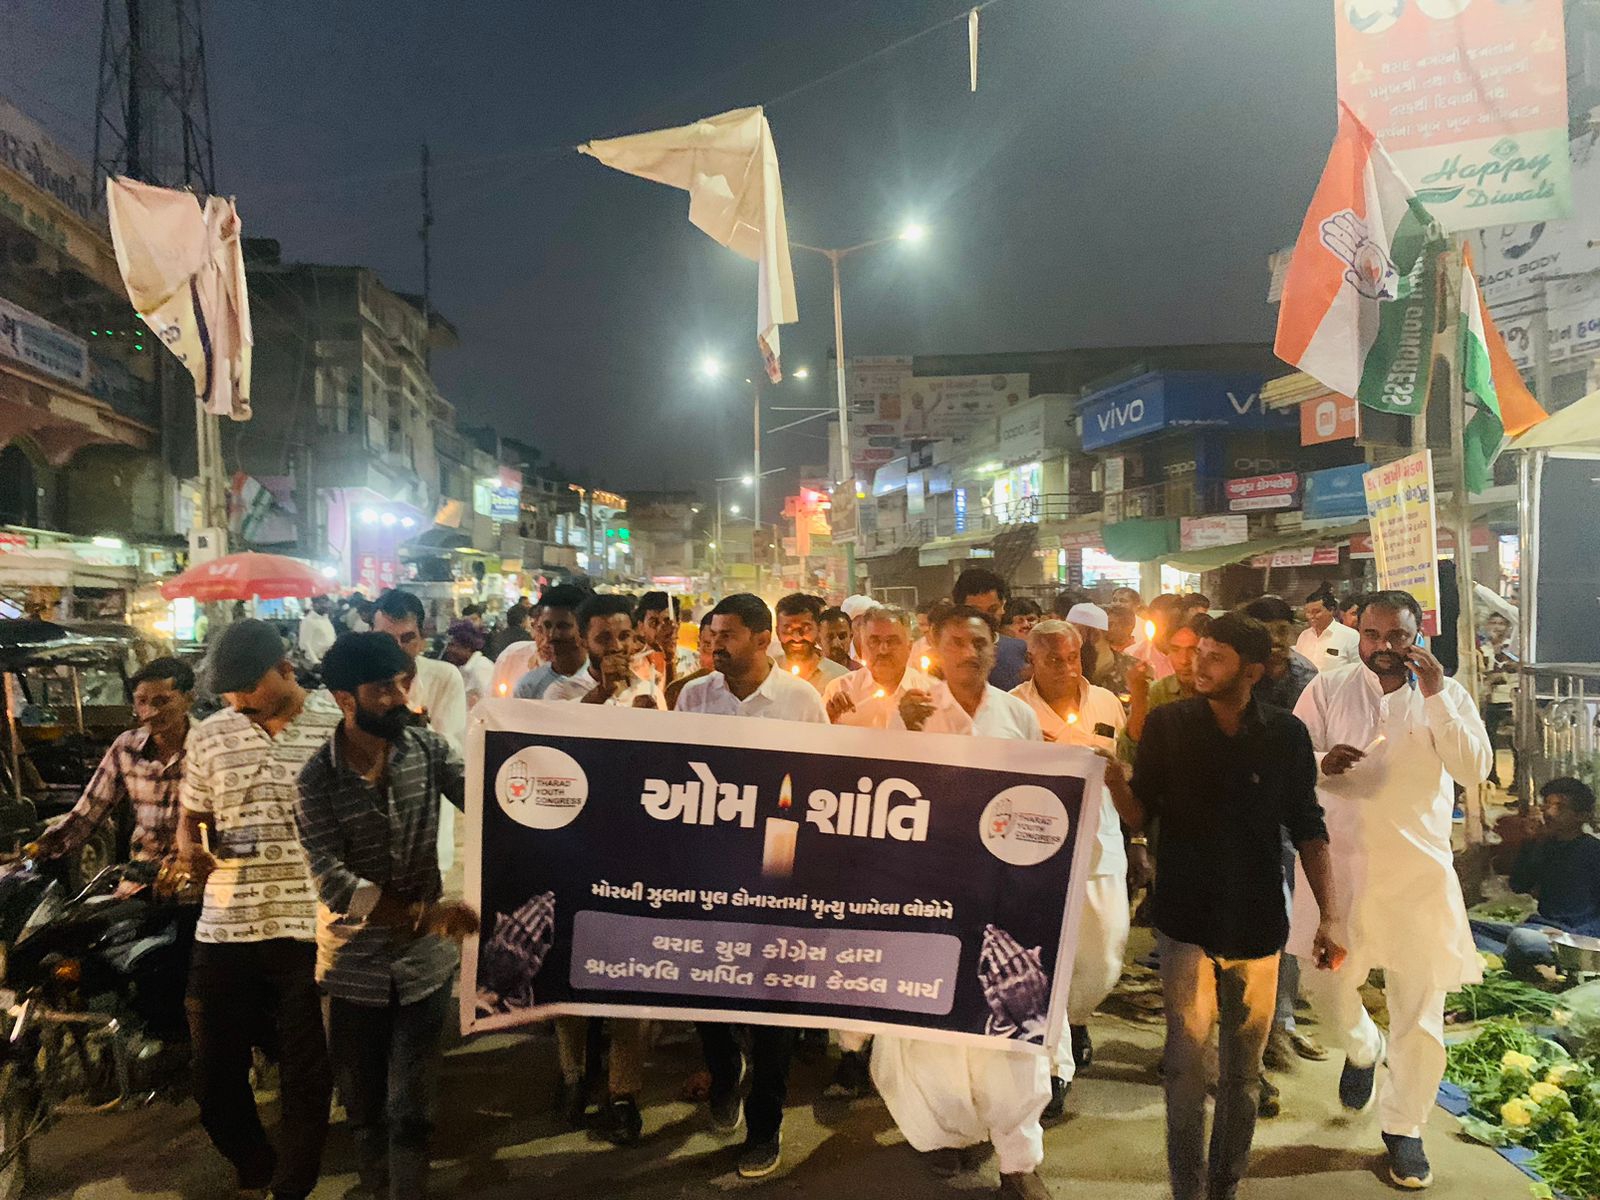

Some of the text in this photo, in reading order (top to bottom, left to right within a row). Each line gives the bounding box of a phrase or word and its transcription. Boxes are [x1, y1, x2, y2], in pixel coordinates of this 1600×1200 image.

[1420, 153, 1552, 186] Happy
[1097, 398, 1145, 432] vivo
[536, 788, 565, 796] YOUTH
[536, 797, 582, 805] CONGRESS
[640, 761, 931, 842] ઓમ શાંતિ
[591, 879, 954, 920] મોરબી ઝુલતા પુલ હોનારતમાં મૃત્યુ પામેલા લોકોને
[652, 935, 705, 954] થરાદ
[715, 940, 752, 963] યુથ
[835, 947, 883, 964] દ્વારા
[584, 957, 944, 1000] શ્રદ્ધાંજલિ અર્પિત કરવા કેન્ડલ માર્ચ
